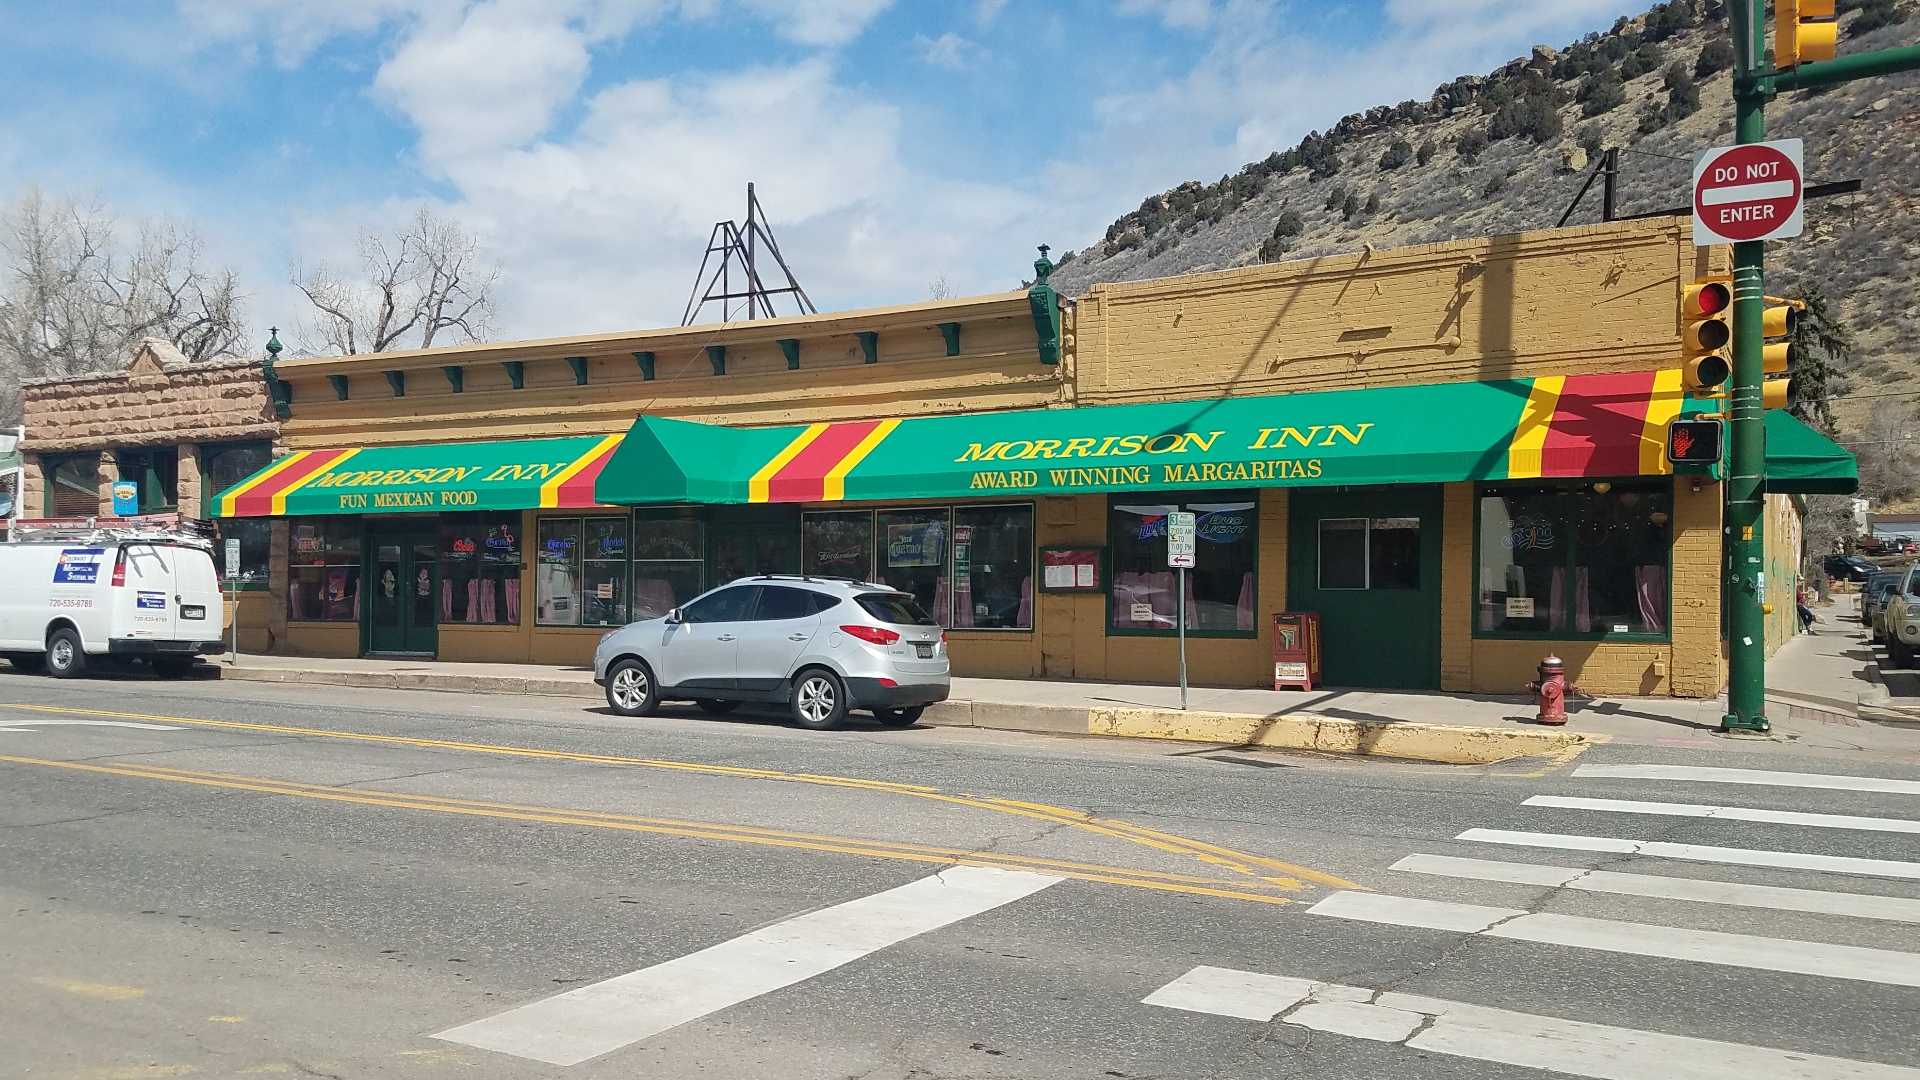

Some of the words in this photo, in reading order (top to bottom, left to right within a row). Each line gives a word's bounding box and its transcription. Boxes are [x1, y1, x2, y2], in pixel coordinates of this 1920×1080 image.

[1715, 166, 1738, 183] DO
[1746, 161, 1780, 179] NOT
[1720, 204, 1775, 224] ENTER
[953, 431, 1225, 463] MORRISON
[1247, 423, 1375, 450] INN
[306, 466, 483, 488] MORRISON
[481, 463, 567, 481] INN
[969, 470, 1038, 489] AWARD
[1049, 465, 1151, 487] WINNING
[1163, 459, 1322, 483] MARGARITAS
[339, 493, 368, 508] FUN
[374, 492, 434, 507] MEXICAN
[441, 490, 478, 506] FOOD
[1171, 515, 1177, 525] 3
[1209, 515, 1244, 525] BUD
[1200, 525, 1248, 534] LIGHT
[1171, 543, 1183, 551] 7:00
[1185, 543, 1192, 551] PM
[49, 599, 93, 608] 720-535-9789
